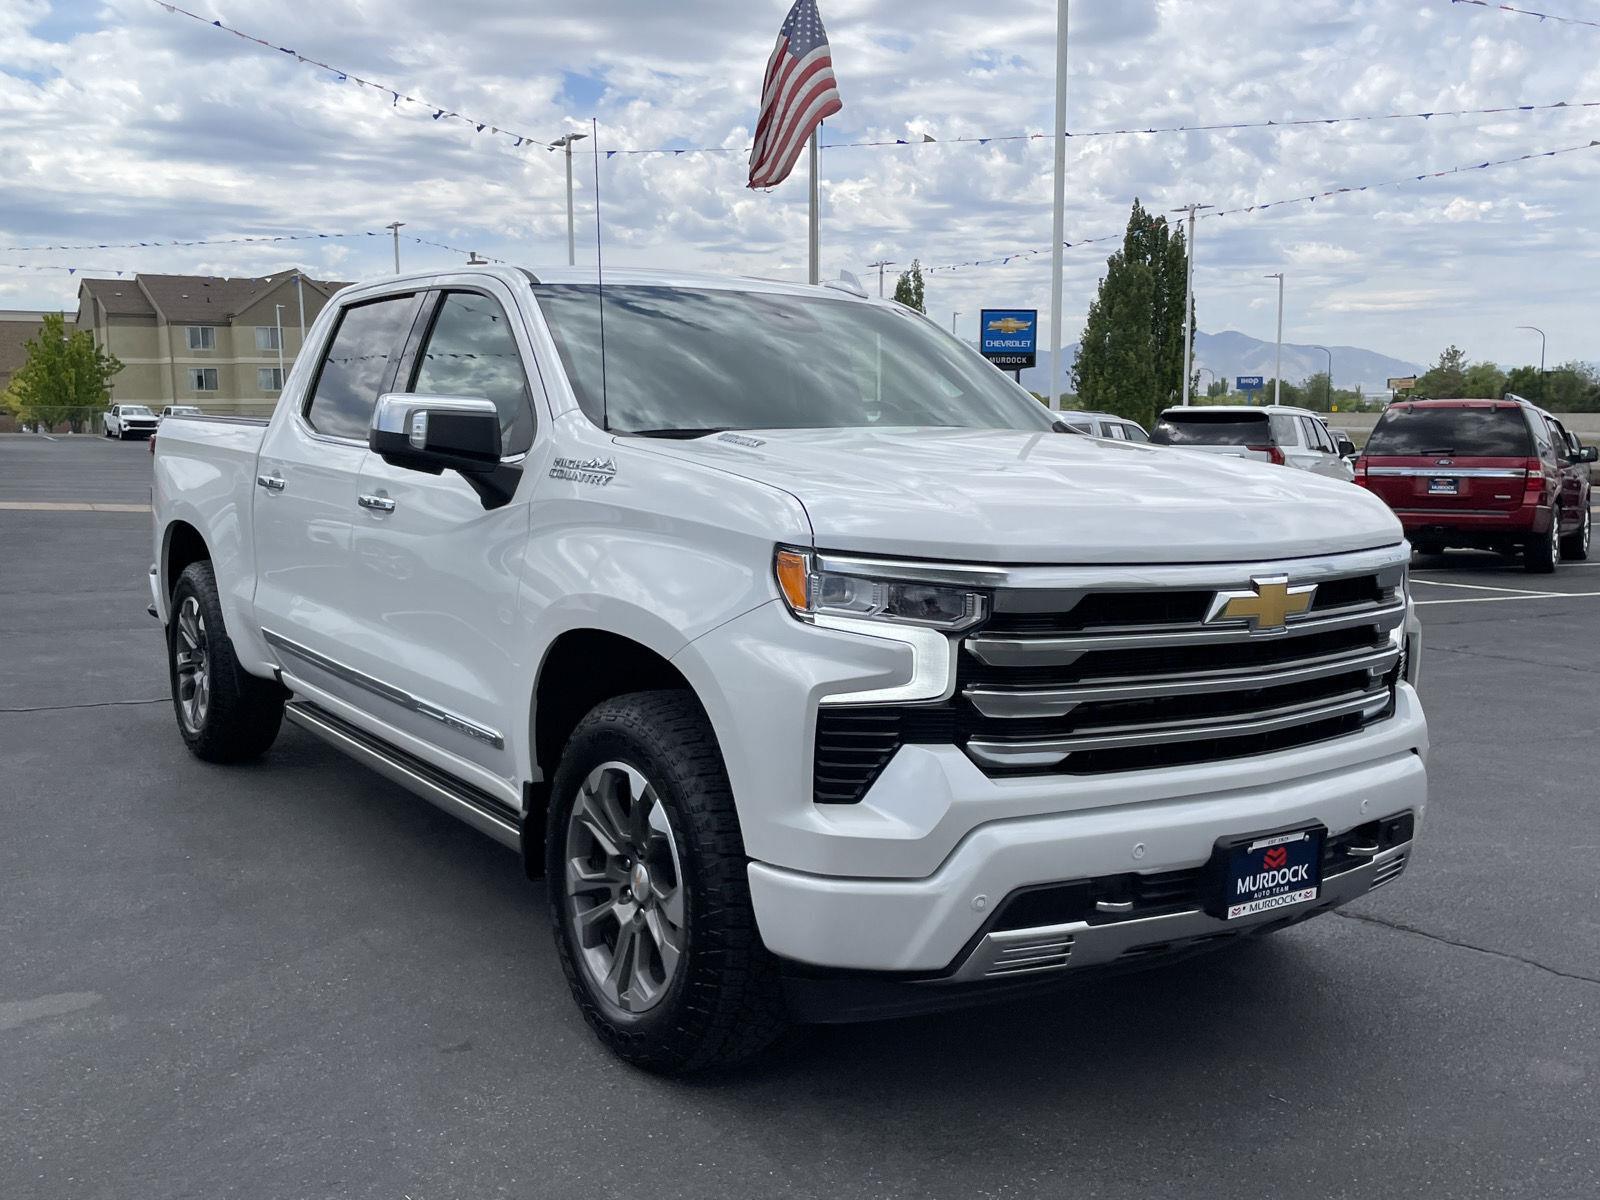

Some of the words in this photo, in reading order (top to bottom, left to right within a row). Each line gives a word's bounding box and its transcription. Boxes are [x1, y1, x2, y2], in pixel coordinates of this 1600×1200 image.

[985, 340, 1031, 348] CHEVROLET
[989, 356, 1027, 364] MURDOCK
[549, 468, 614, 486] COUNTRY
[1237, 863, 1309, 895] MURDOCK
[1253, 891, 1270, 899] AUTO
[1272, 885, 1289, 894] TEAM
[1249, 893, 1297, 912] MURDOCK
